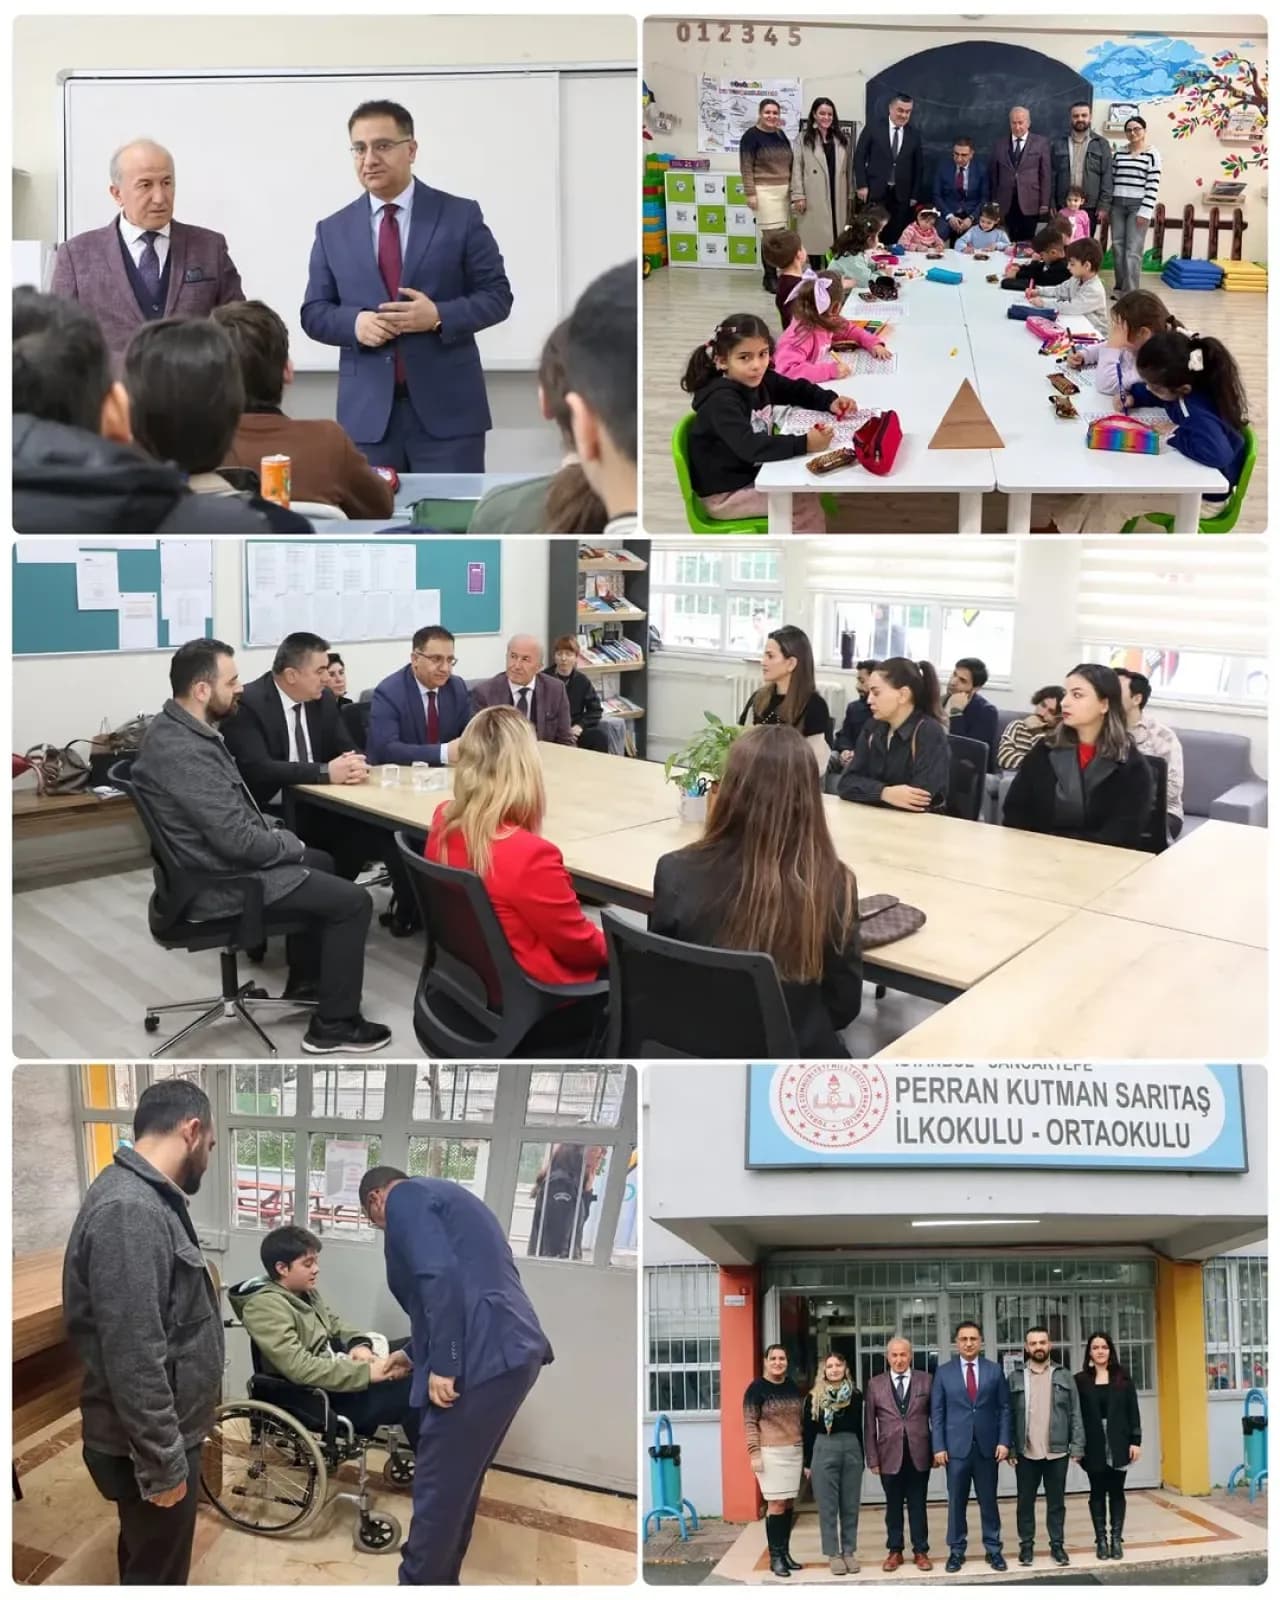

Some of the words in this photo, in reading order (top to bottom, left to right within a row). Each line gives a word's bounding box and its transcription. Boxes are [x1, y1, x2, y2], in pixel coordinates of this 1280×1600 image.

[676, 22, 691, 42] 0
[697, 22, 710, 42] 1
[718, 23, 731, 43] 2
[741, 23, 754, 44] 3
[763, 26, 778, 46] 4
[788, 26, 802, 47] 5
[896, 1077, 998, 1104] PERRAN
[1007, 1078, 1108, 1107] KUTMAN
[1116, 1081, 1211, 1117] SARITAŞ
[896, 1110, 1024, 1145] İLKOKULU
[1046, 1118, 1190, 1149] ORTAOKULU
